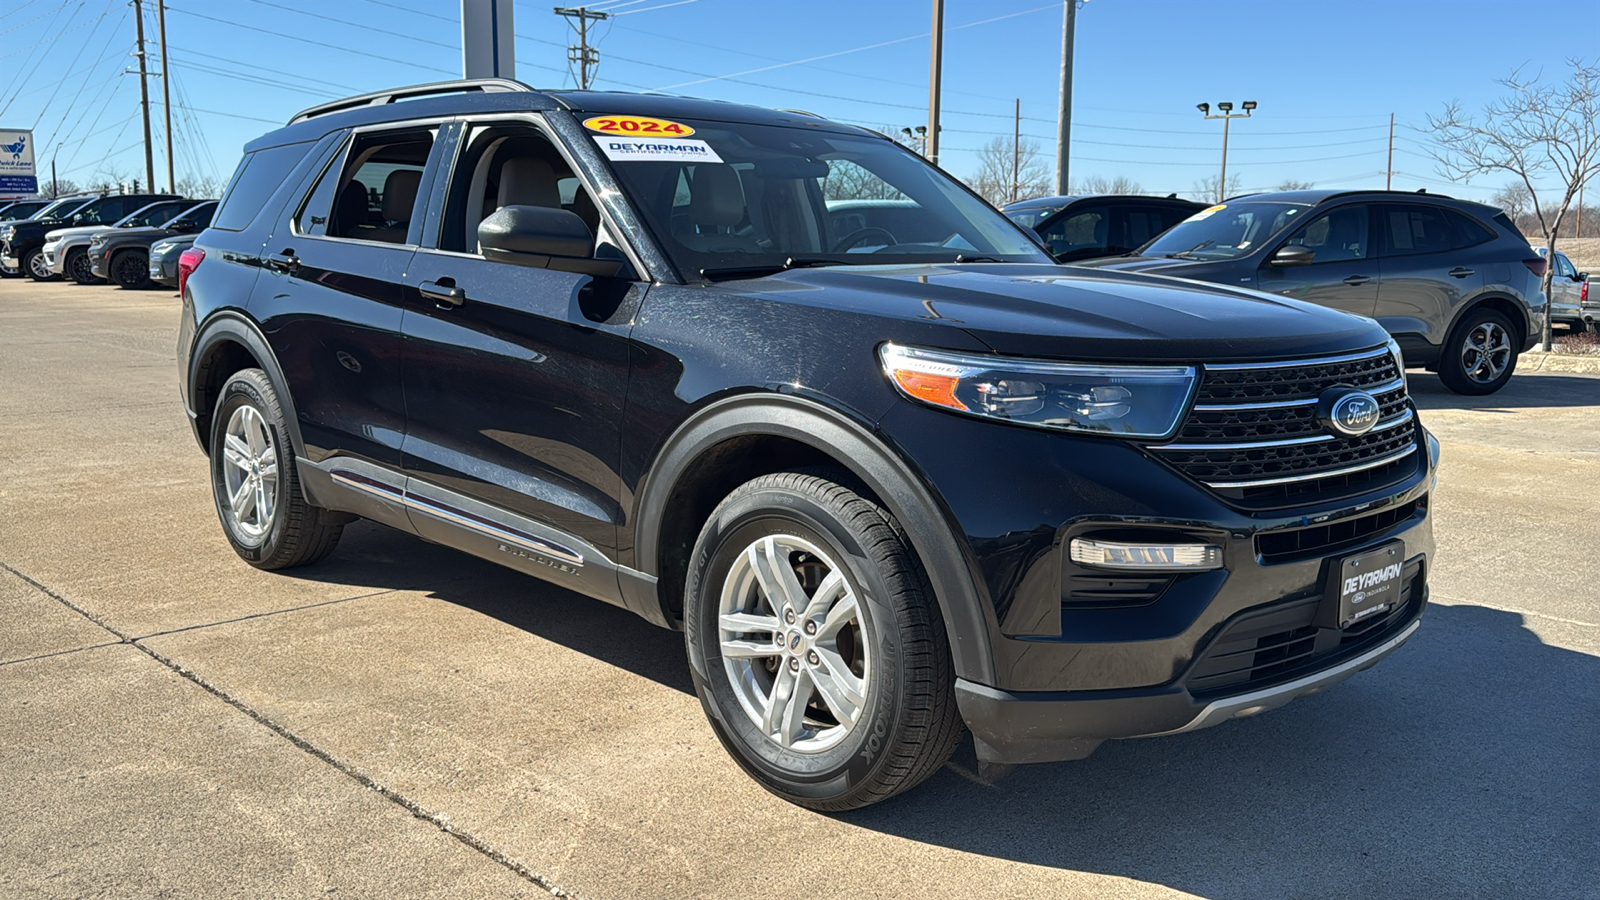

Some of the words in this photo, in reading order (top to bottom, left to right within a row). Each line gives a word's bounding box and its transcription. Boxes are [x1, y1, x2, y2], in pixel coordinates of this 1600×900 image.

[597, 119, 685, 134] 2024
[609, 142, 706, 152] DEYARMAN
[1347, 401, 1373, 425] Ford
[1343, 562, 1402, 596] DEYARMAN
